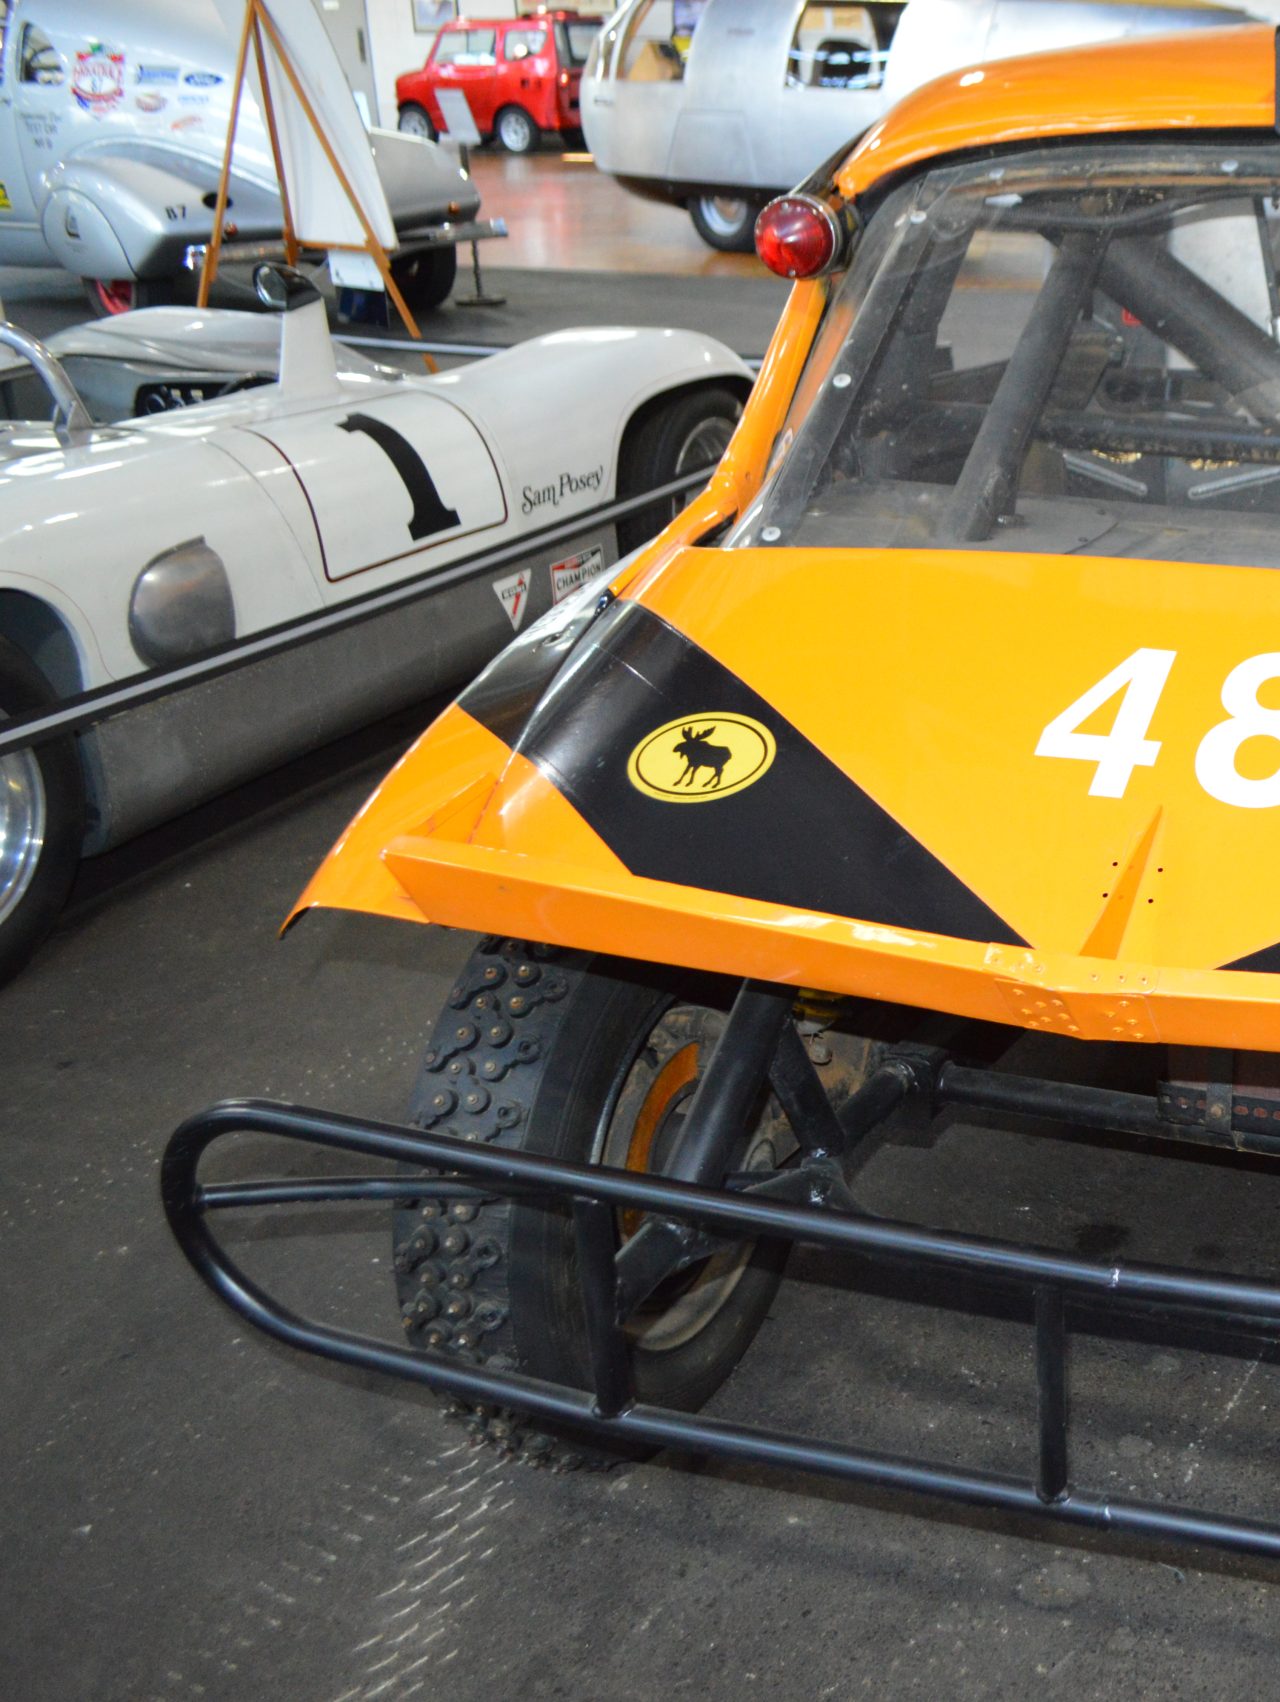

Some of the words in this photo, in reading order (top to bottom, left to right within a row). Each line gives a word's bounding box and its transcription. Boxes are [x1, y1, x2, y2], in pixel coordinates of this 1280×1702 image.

[336, 412, 462, 541] 1
[521, 485, 559, 515] Sam
[559, 464, 604, 497] Posey
[556, 562, 602, 591] CHAMPION
